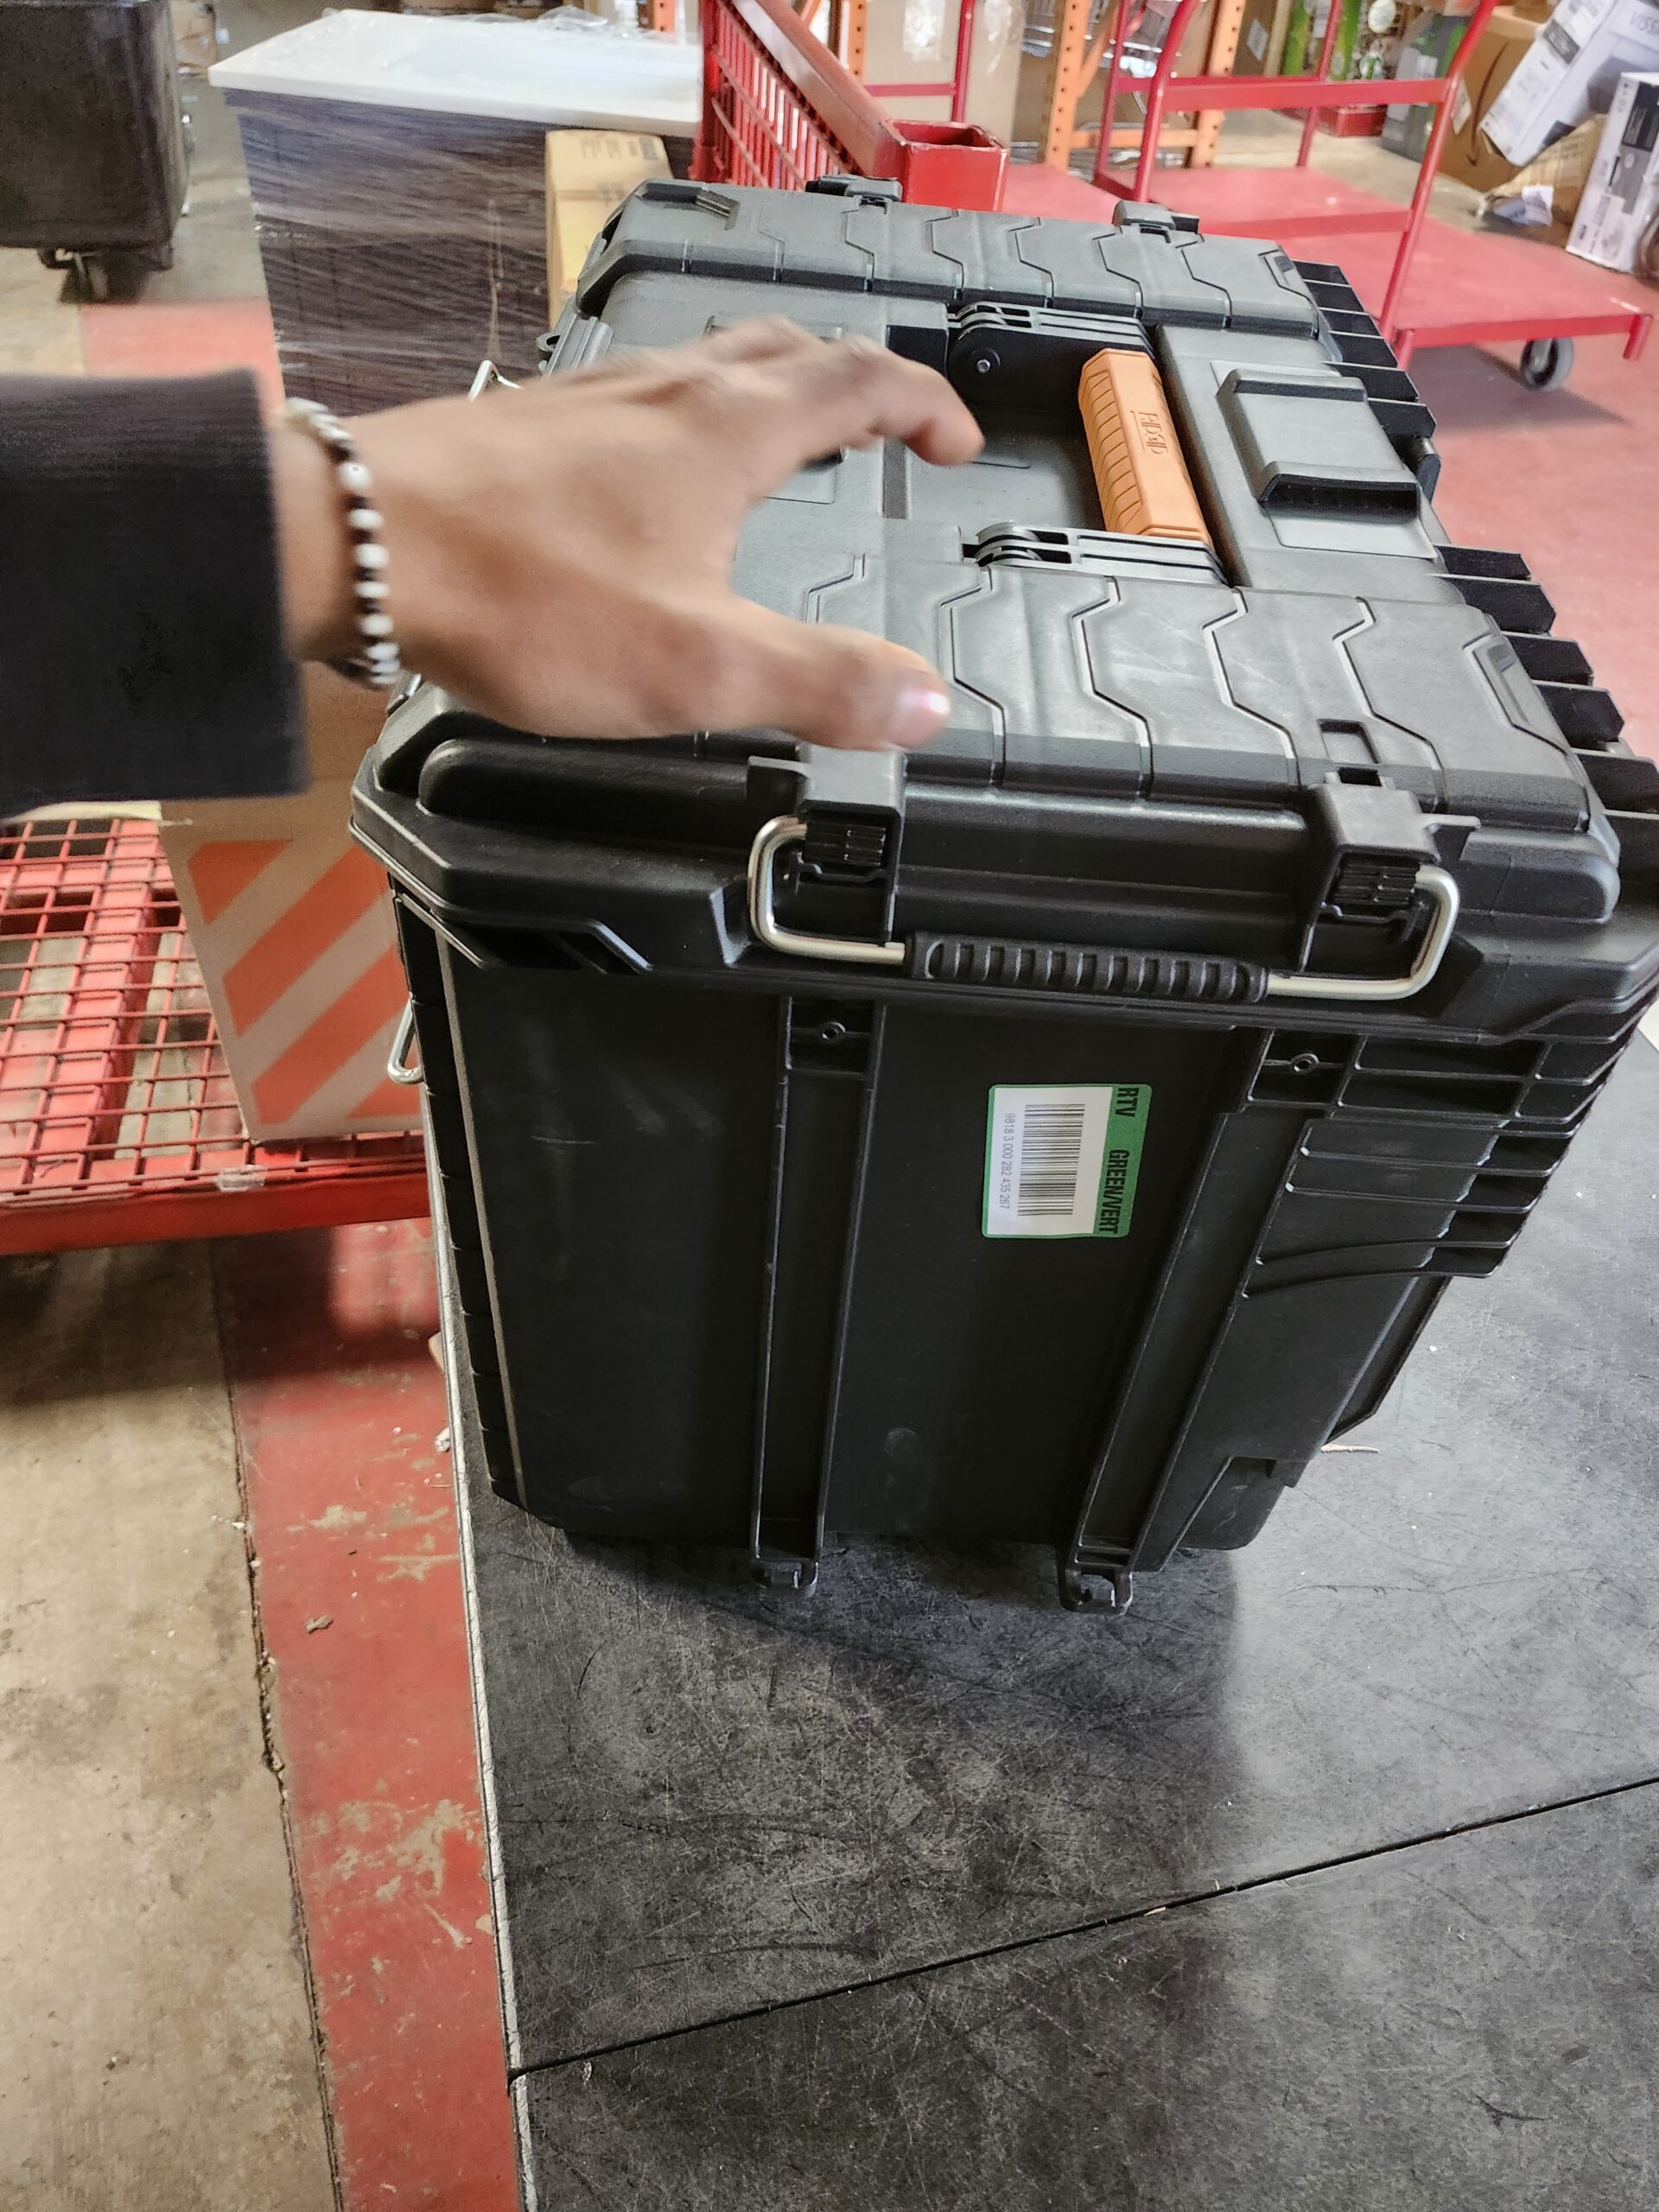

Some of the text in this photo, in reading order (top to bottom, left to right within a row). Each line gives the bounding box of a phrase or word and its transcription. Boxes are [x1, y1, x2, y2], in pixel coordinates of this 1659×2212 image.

[1003, 1112, 1015, 1134] 9818
[1001, 1144, 1014, 1159] 000
[1099, 1087, 1139, 1234] RTV GREEN/VERT
[1001, 1161, 1013, 1176] 282
[1000, 1177, 1011, 1192] 435
[999, 1194, 1011, 1210] 267
